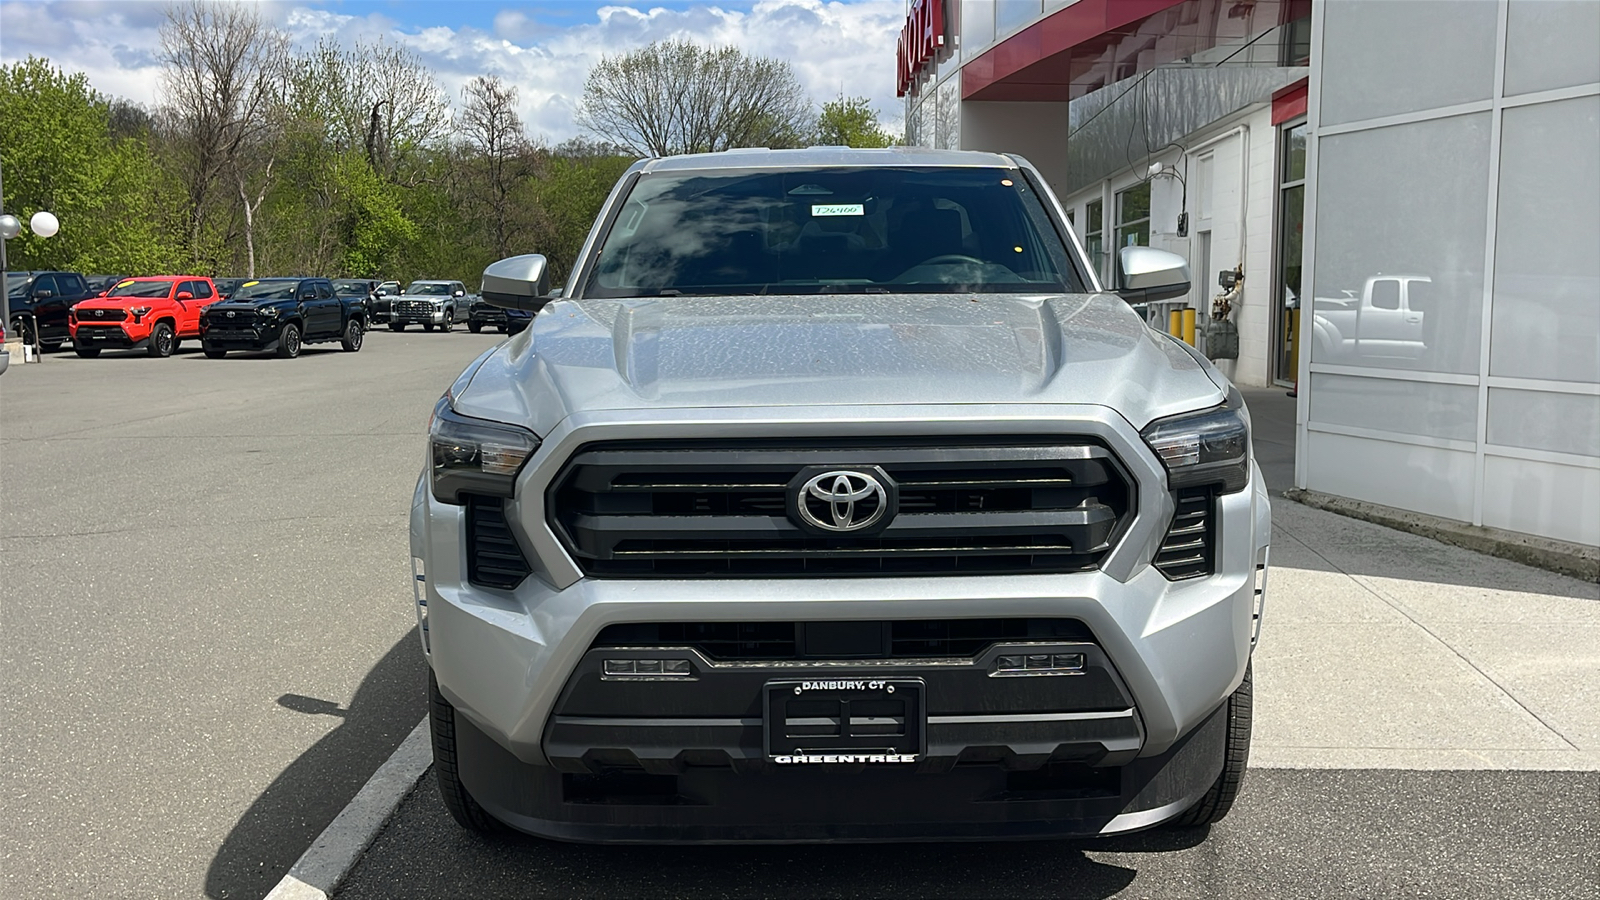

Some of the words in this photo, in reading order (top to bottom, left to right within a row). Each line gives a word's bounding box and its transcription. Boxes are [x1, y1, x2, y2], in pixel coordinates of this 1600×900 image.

[897, 0, 944, 97] OYOTA
[802, 681, 865, 691] DANBURY,
[868, 680, 886, 690] CT
[774, 755, 915, 763] GREENTREE
